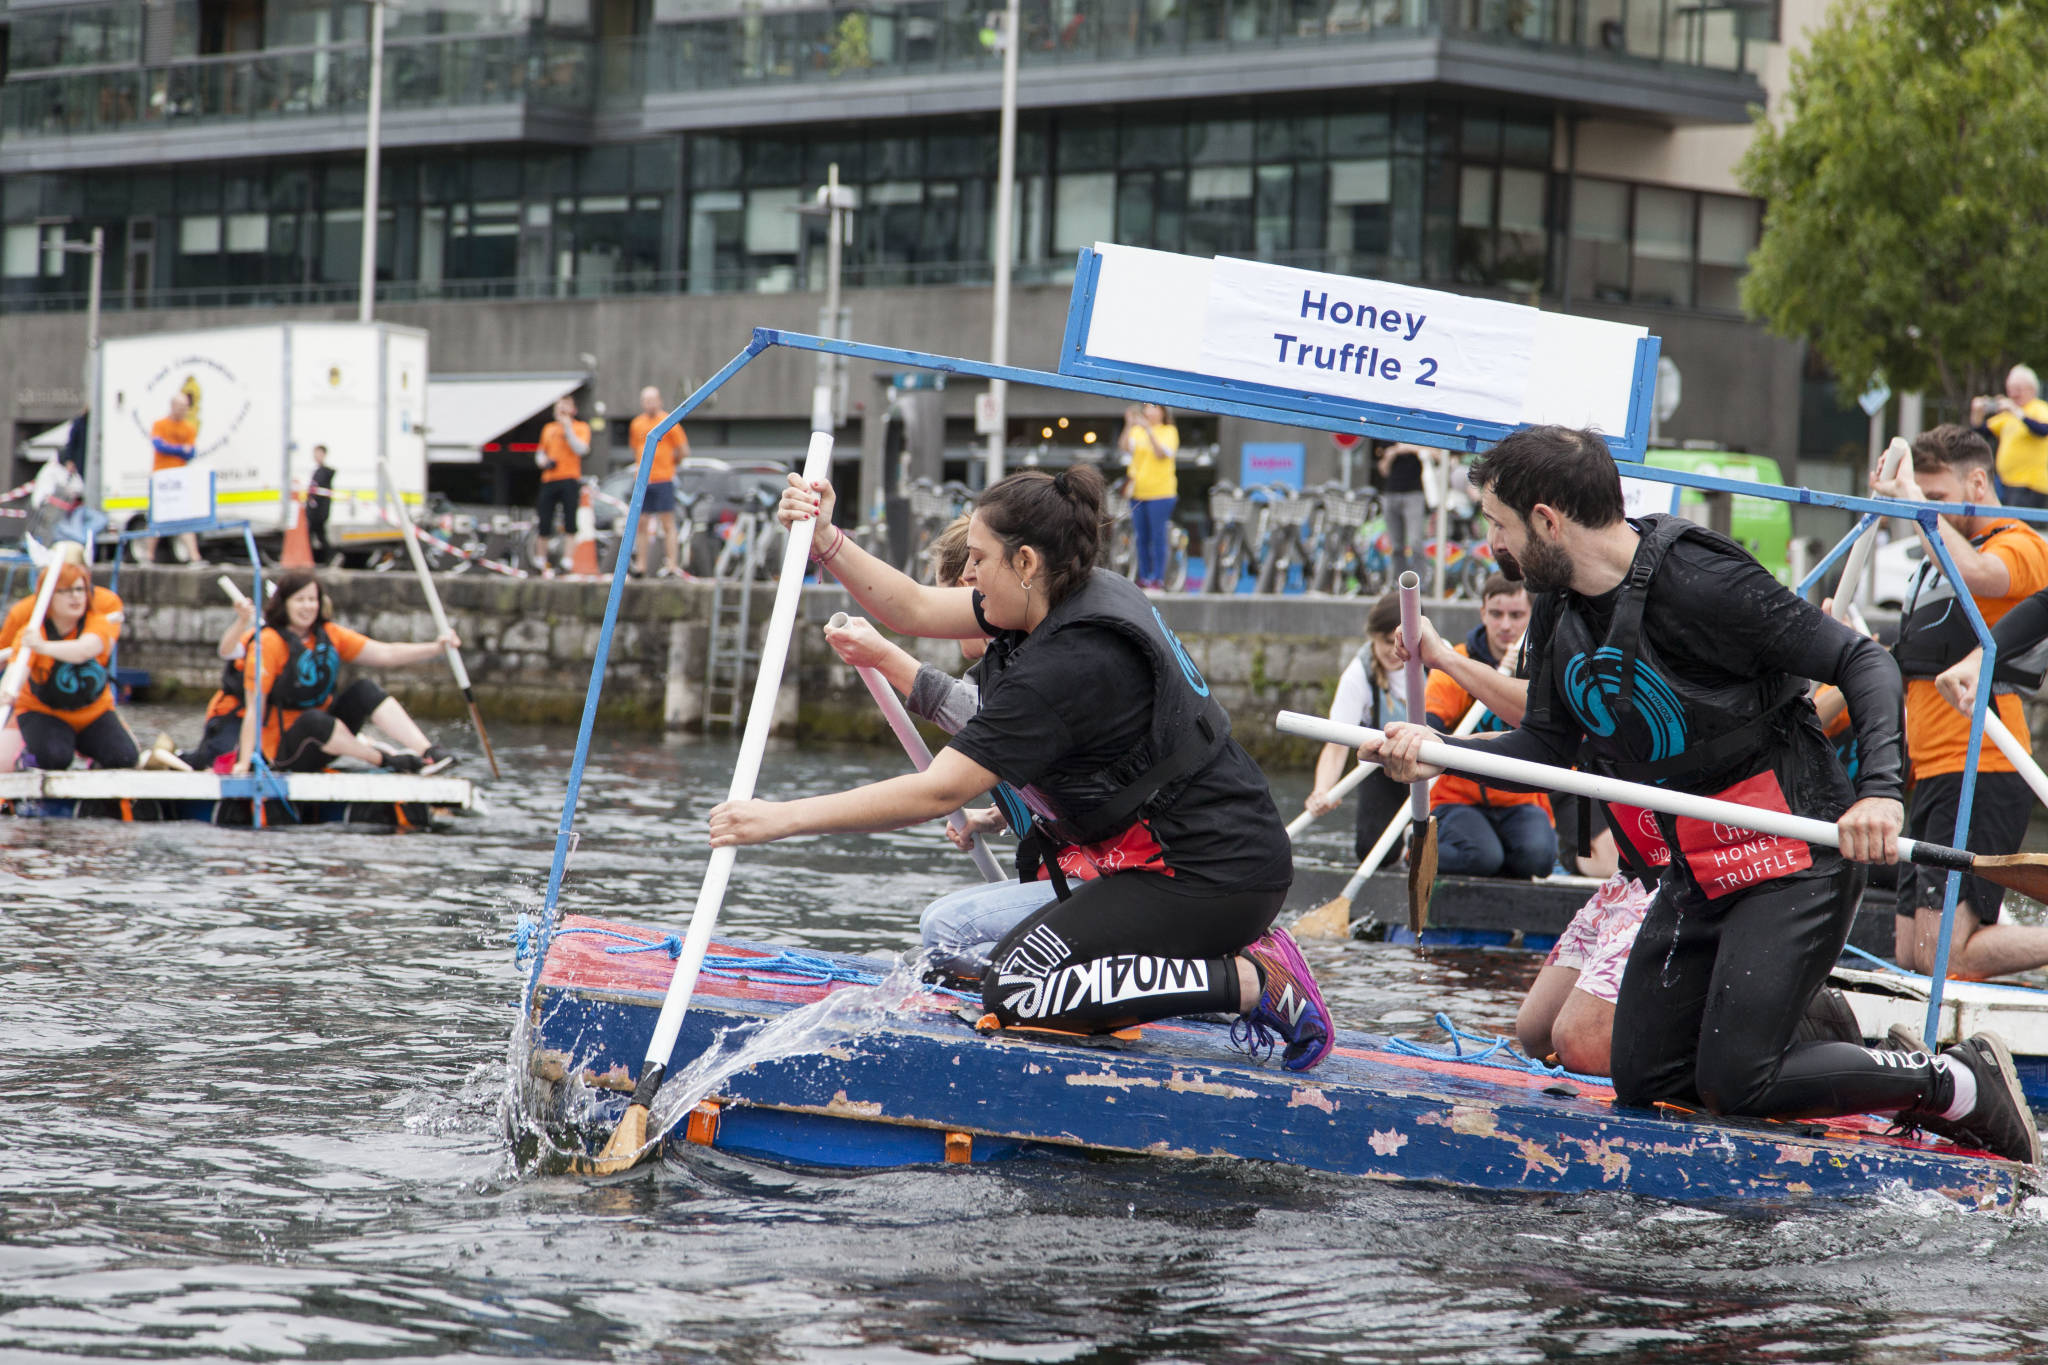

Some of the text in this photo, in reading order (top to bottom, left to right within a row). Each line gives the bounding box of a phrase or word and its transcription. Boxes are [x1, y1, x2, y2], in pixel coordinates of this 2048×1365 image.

[1300, 289, 1427, 342] Honey
[1273, 332, 1439, 387] Truffle 2
[1648, 689, 1675, 725] TYPHOON
[1713, 834, 1780, 868] HONEY
[1713, 849, 1798, 891] TRUFFLE
